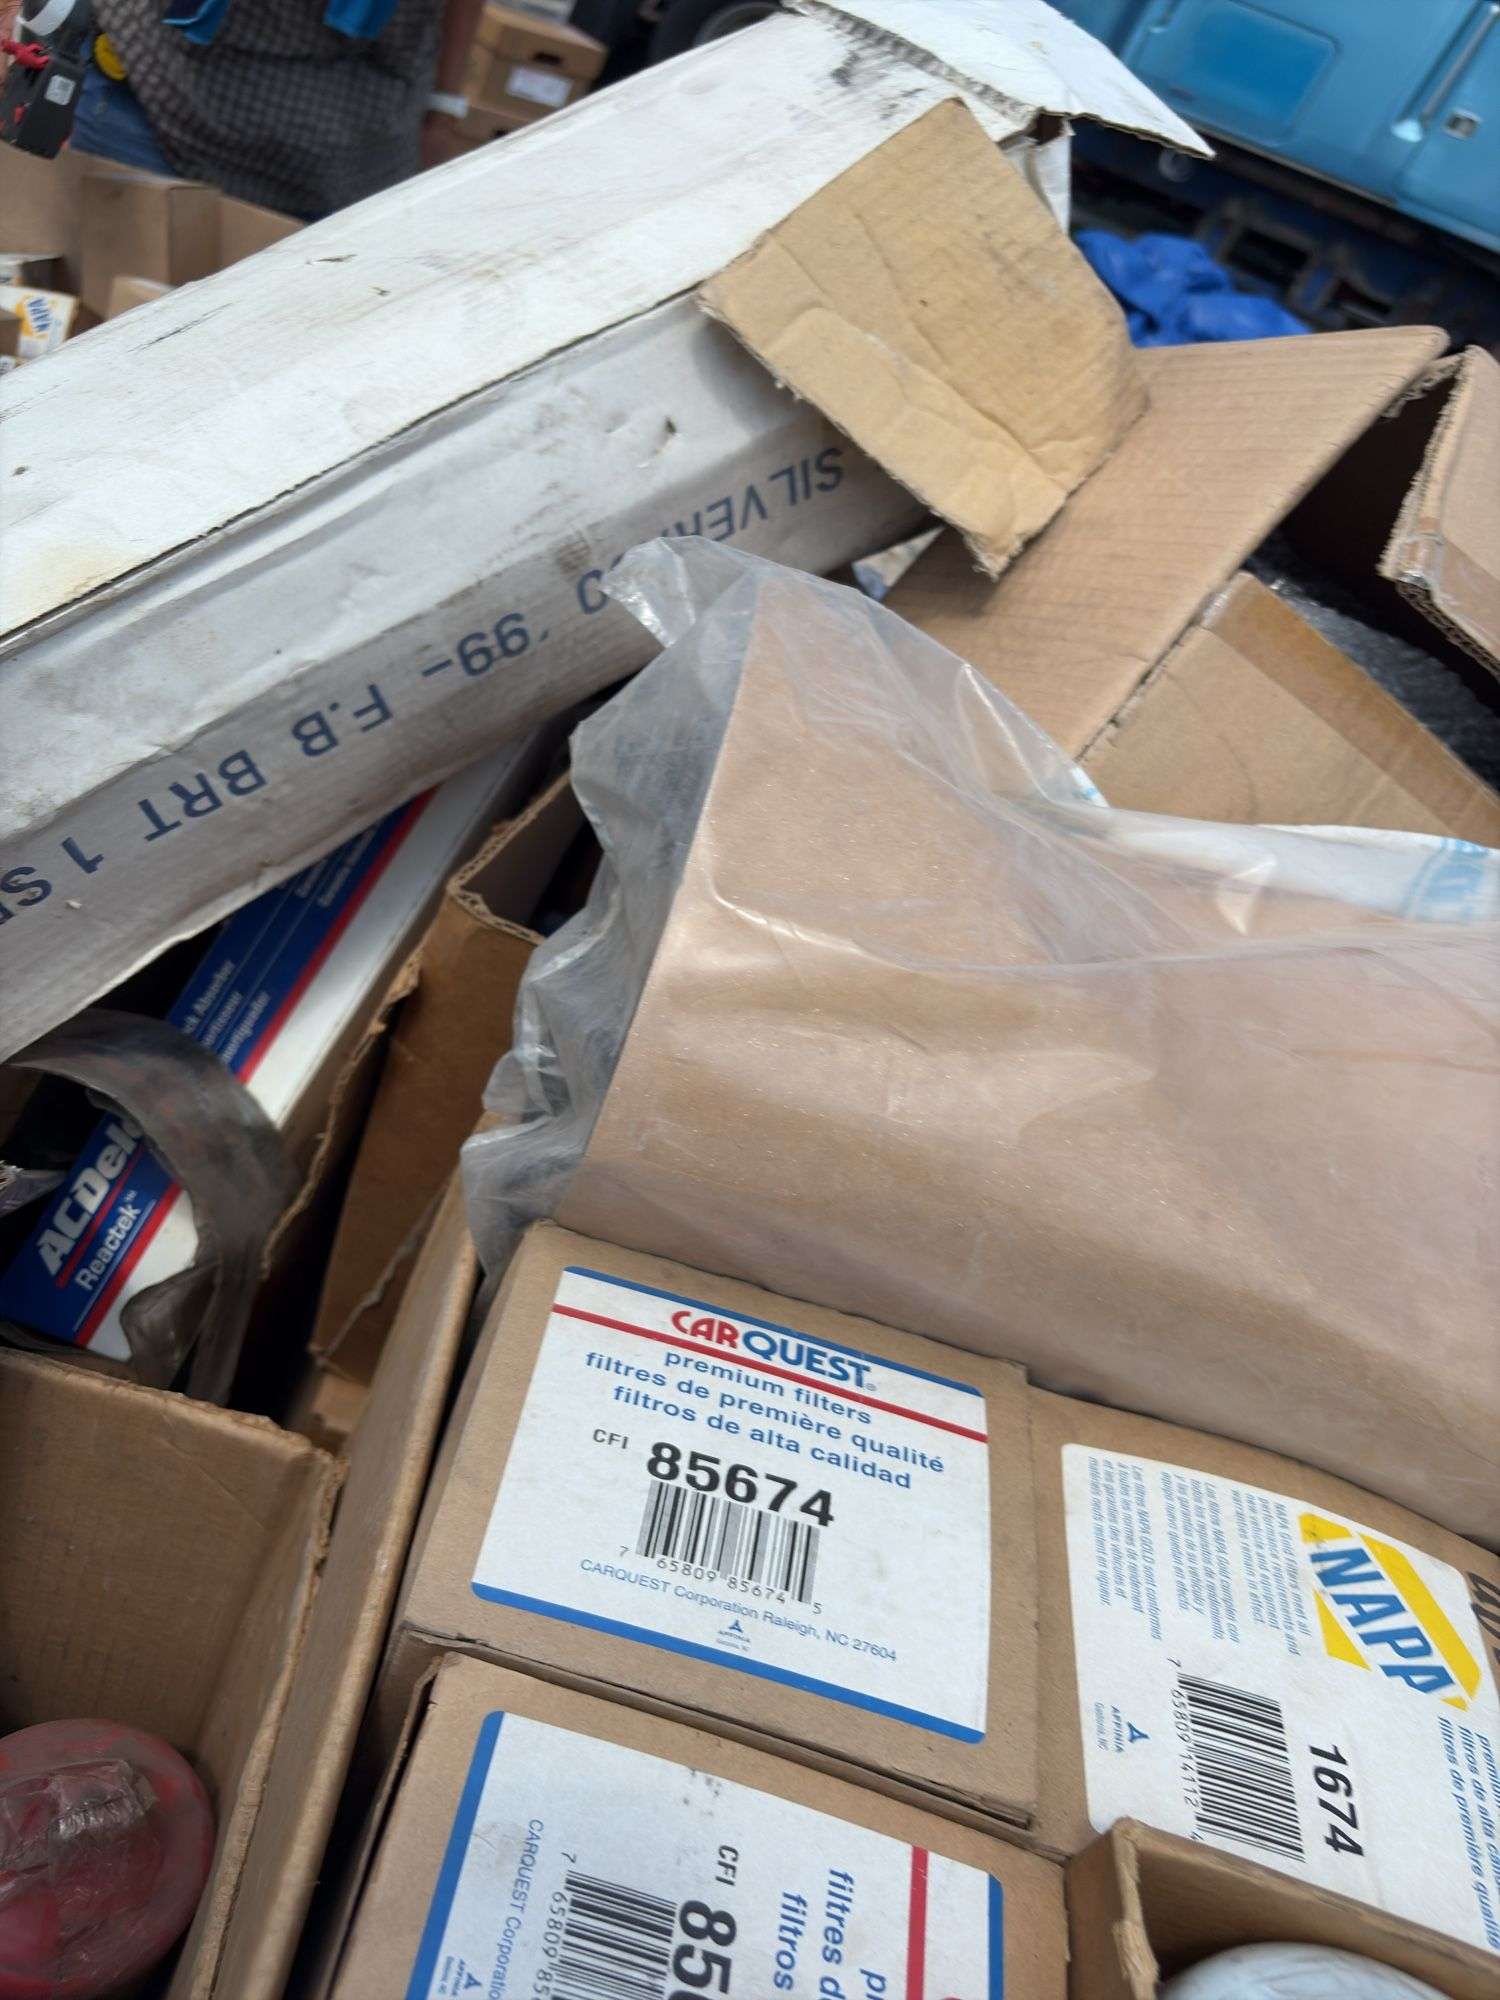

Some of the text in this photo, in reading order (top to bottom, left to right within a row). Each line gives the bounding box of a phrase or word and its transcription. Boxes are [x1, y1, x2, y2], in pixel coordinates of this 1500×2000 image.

[576, 448, 844, 614] SILVERO
[137, 750, 267, 842] BRT
[62, 836, 104, 874] 1
[671, 1310, 870, 1388] CARQUEST
[586, 1351, 944, 1474] filtres de première qualité
[664, 1352, 872, 1425] premium filters
[613, 1384, 911, 1489] filtros de alta calidad
[592, 1427, 835, 1528] CFI 85674
[1274, 1502, 1290, 1530] NAPA
[579, 1558, 671, 1594] CARQUEST
[673, 1585, 759, 1619] Corporation
[763, 1611, 820, 1641] Raleigh,
[826, 1630, 849, 1647] NC
[852, 1638, 897, 1662] 27604
[619, 1546, 822, 1615] 7 65809 85674 5
[1310, 1547, 1454, 1695] NAPA
[1167, 1657, 1182, 1668] 7
[1170, 1688, 1191, 1744] 65809
[1438, 1716, 1458, 1765] filtres
[1450, 1769, 1465, 1791] de
[1458, 1725, 1479, 1775] filtros
[1181, 1753, 1198, 1808] 14112
[1309, 1745, 1364, 1856] 1674
[1472, 1779, 1487, 1802] de
[1478, 1804, 1496, 1839] alta
[510, 1819, 544, 1914] CARQUEST
[715, 1845, 739, 1886] CFI
[533, 1851, 577, 2000] 7 65809 85
[774, 1892, 807, 1991] filtros
[822, 1869, 855, 1965] filtres
